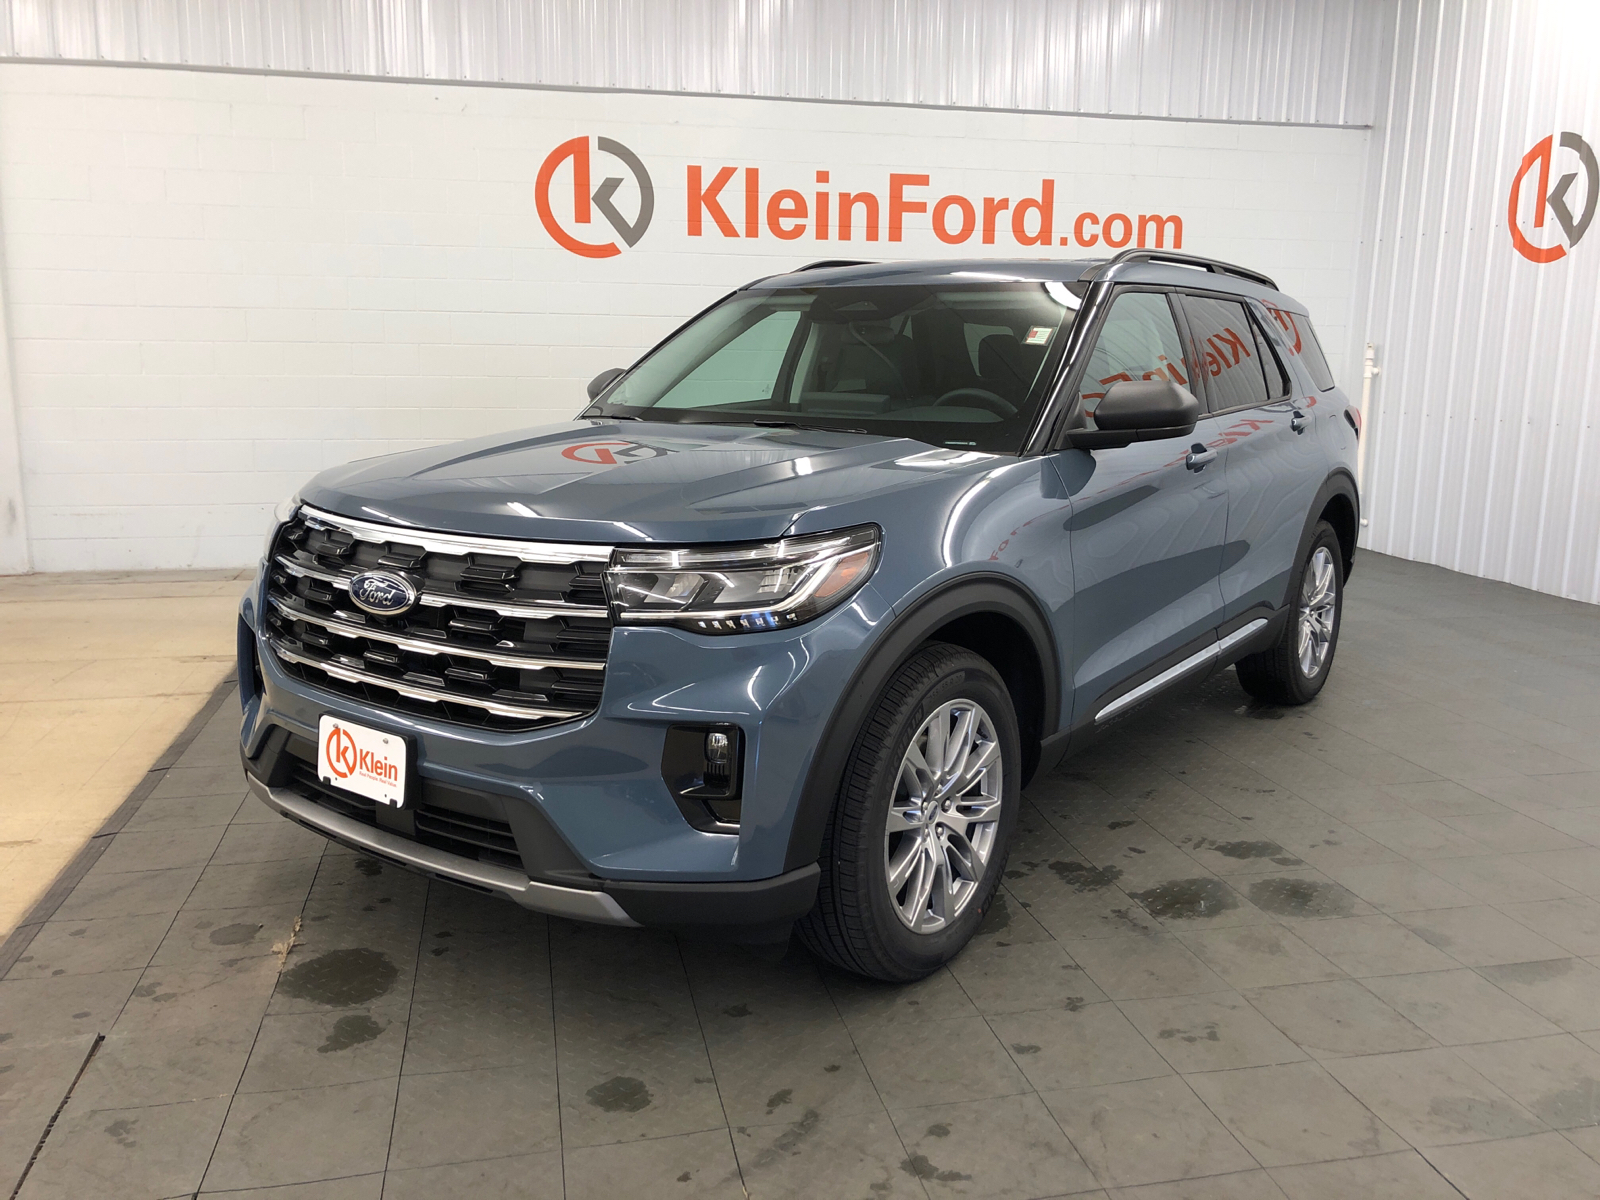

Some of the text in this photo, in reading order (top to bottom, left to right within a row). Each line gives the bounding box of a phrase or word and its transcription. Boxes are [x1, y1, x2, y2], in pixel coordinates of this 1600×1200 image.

[686, 163, 1184, 250] KleinFord.com
[360, 579, 395, 605] Ford
[359, 748, 398, 782] Klein
